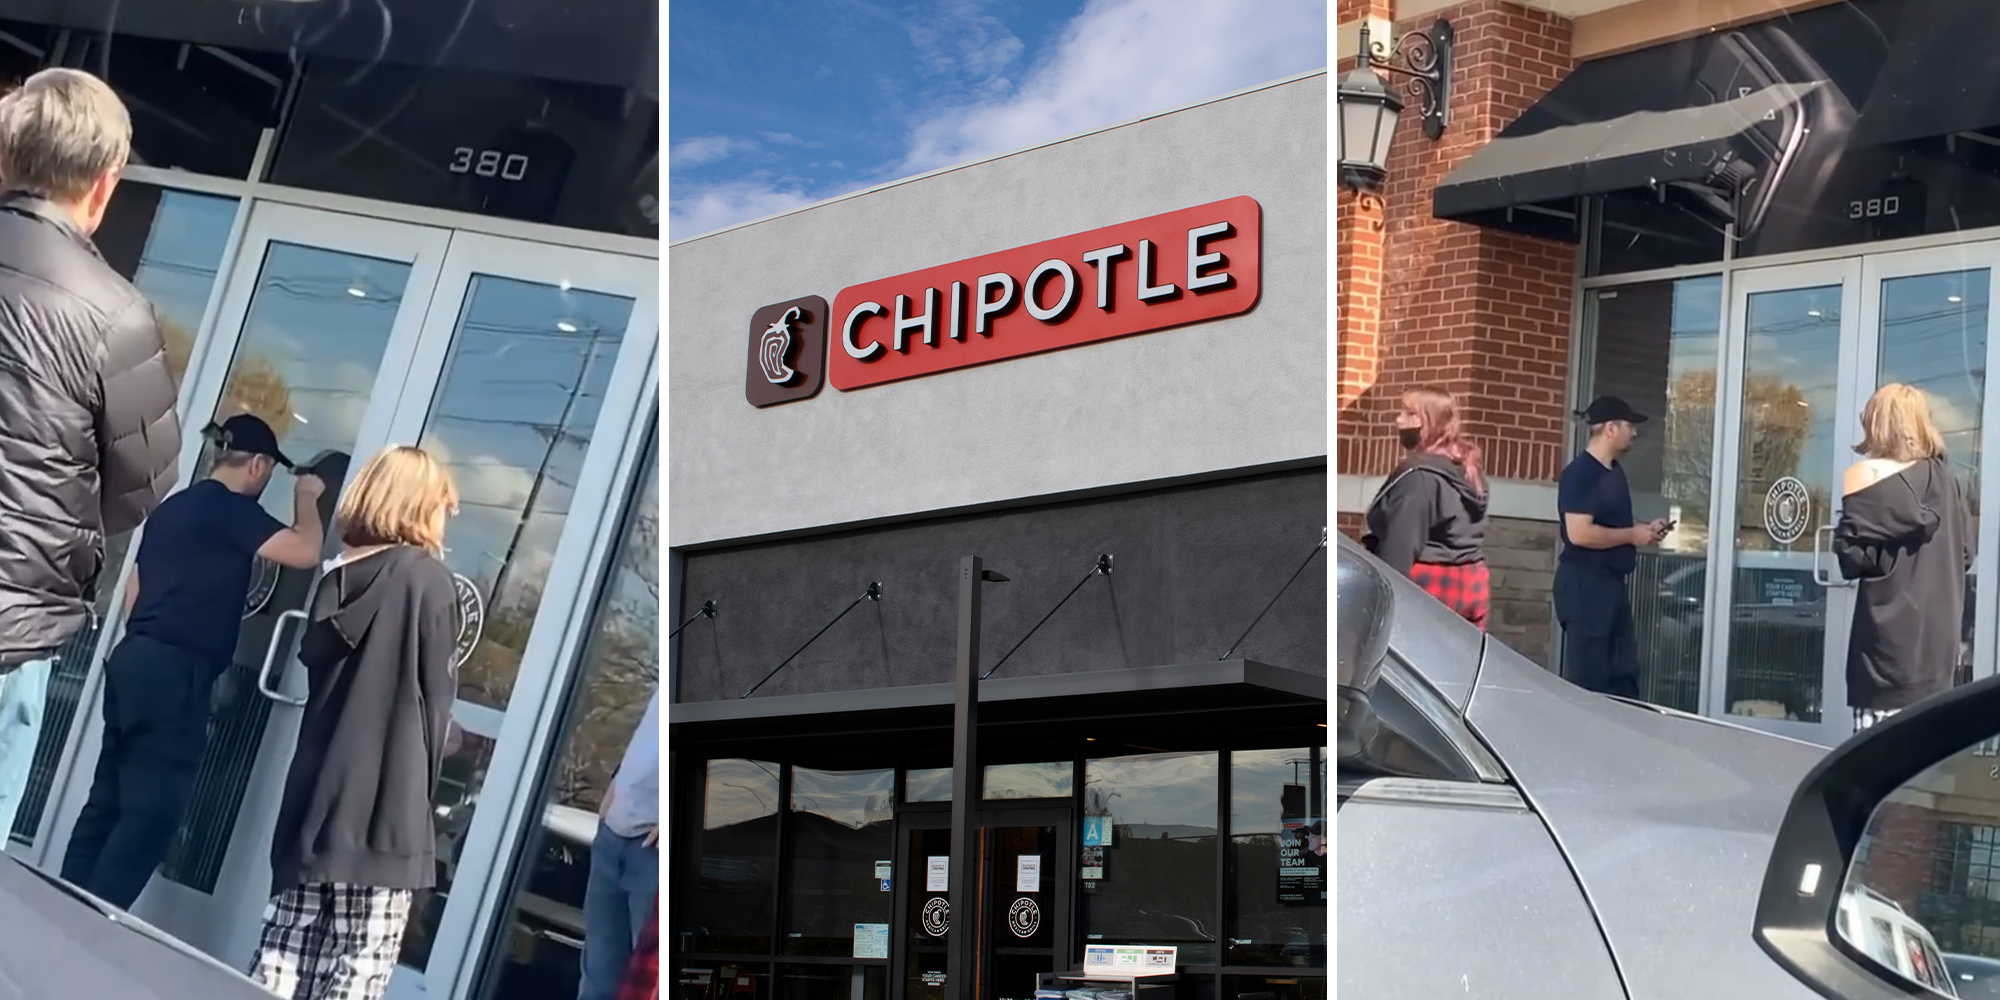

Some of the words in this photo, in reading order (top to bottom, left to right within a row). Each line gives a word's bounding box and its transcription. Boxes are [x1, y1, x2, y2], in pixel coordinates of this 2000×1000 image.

[449, 146, 529, 180] 380
[1849, 196, 1899, 219] 380
[842, 221, 1231, 360] CHIPOTLE
[1768, 481, 1806, 506] CHIPOTLE
[1086, 823, 1099, 840] A
[1281, 839, 1301, 847] JOIN
[1280, 849, 1299, 857] OUR
[1280, 858, 1305, 867] TEAM
[925, 900, 949, 915] CHIPOTLE
[1011, 900, 1037, 915] CHIPOTLE
